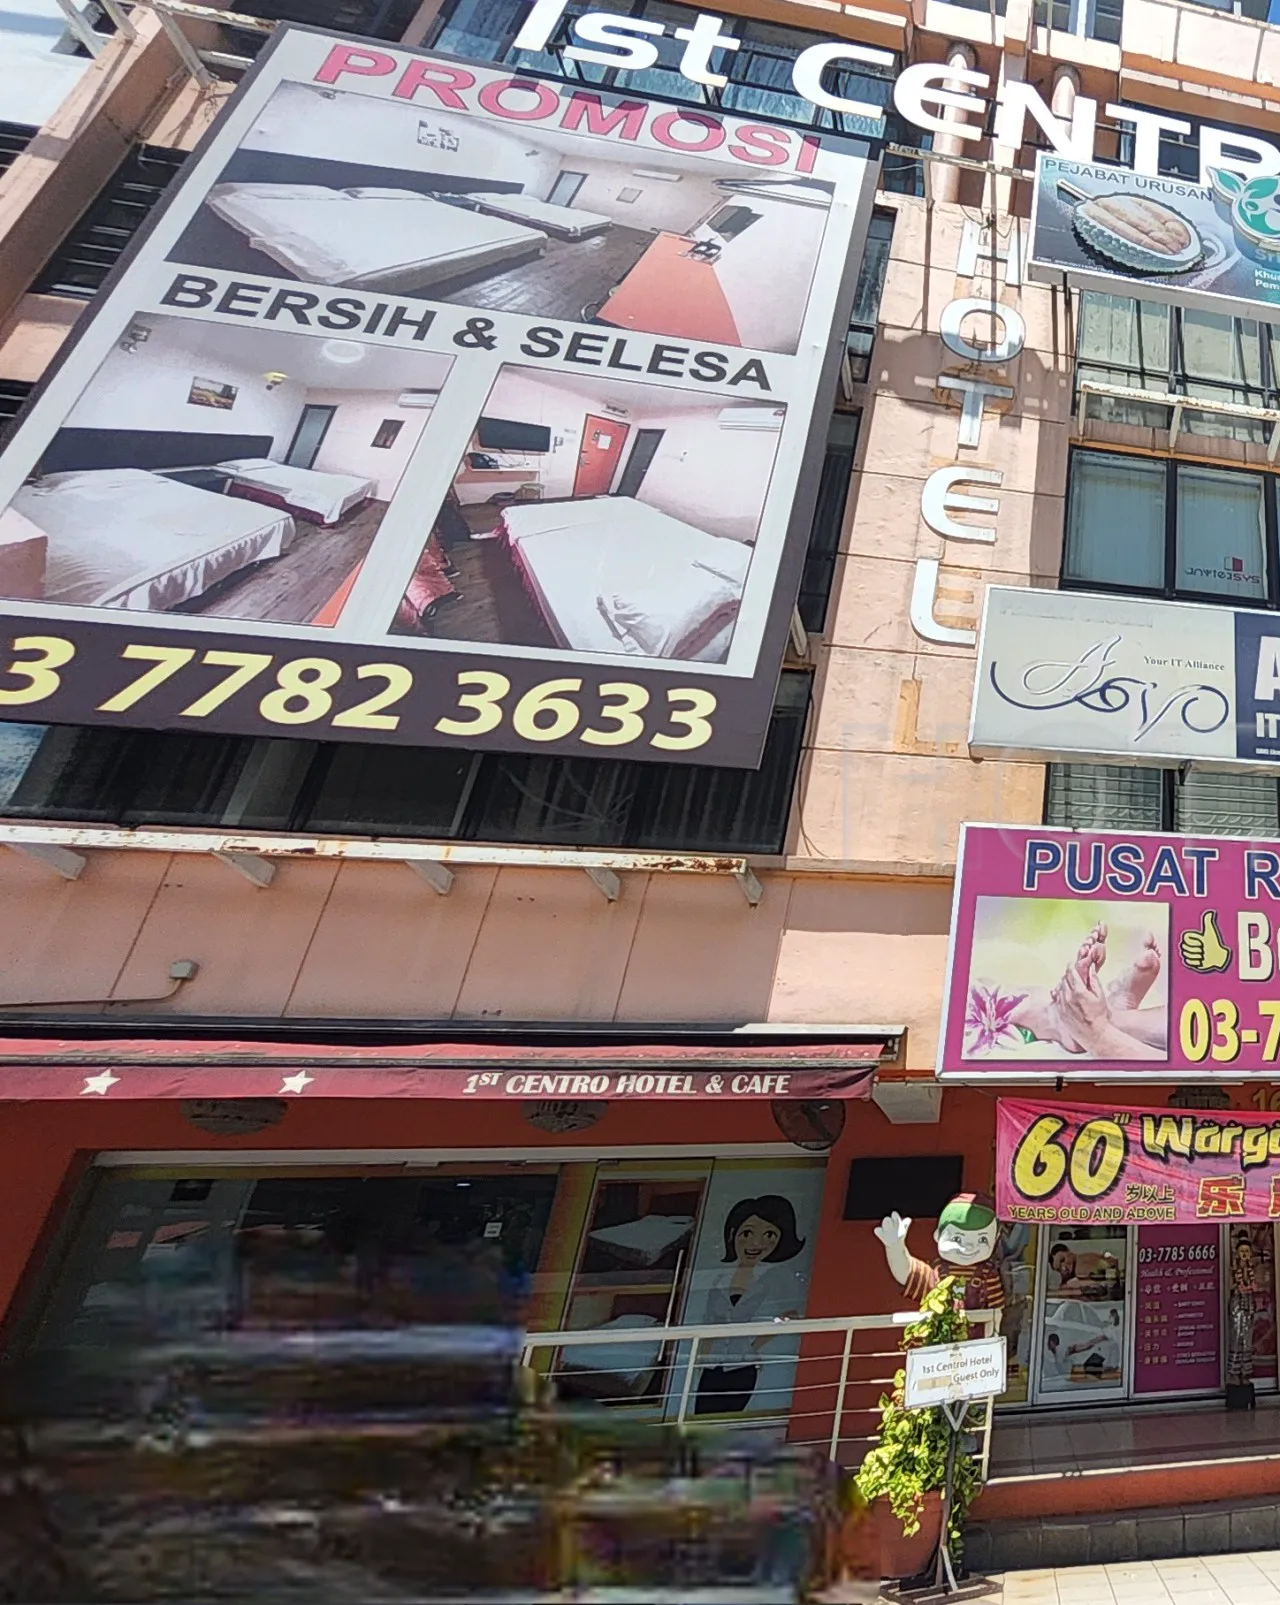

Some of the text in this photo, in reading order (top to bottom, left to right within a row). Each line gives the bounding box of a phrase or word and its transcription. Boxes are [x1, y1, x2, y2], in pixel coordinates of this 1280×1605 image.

[313, 41, 823, 175] PROMOSI
[1045, 159, 1213, 202] PEJABAT URUSAN
[1254, 250, 1280, 264] Sri
[160, 273, 773, 391] BERSIH & SELESA
[910, 218, 1027, 647] HOTEL
[1143, 655, 1225, 672] Your IT Alliance
[98, 643, 414, 731] 7782
[433, 671, 720, 751] 3633
[1022, 839, 1220, 898] PUSAT
[463, 1072, 791, 1095] 1ST CENTRO HOTEL & CAFE
[1008, 1206, 1176, 1220] YEARS OLD AND ABOVE
[1139, 1245, 1216, 1262] 03-7785 6666
[922, 1364, 935, 1374] 1st
[970, 1354, 993, 1367] Hotel
[953, 1368, 1000, 1383] Guest Only
